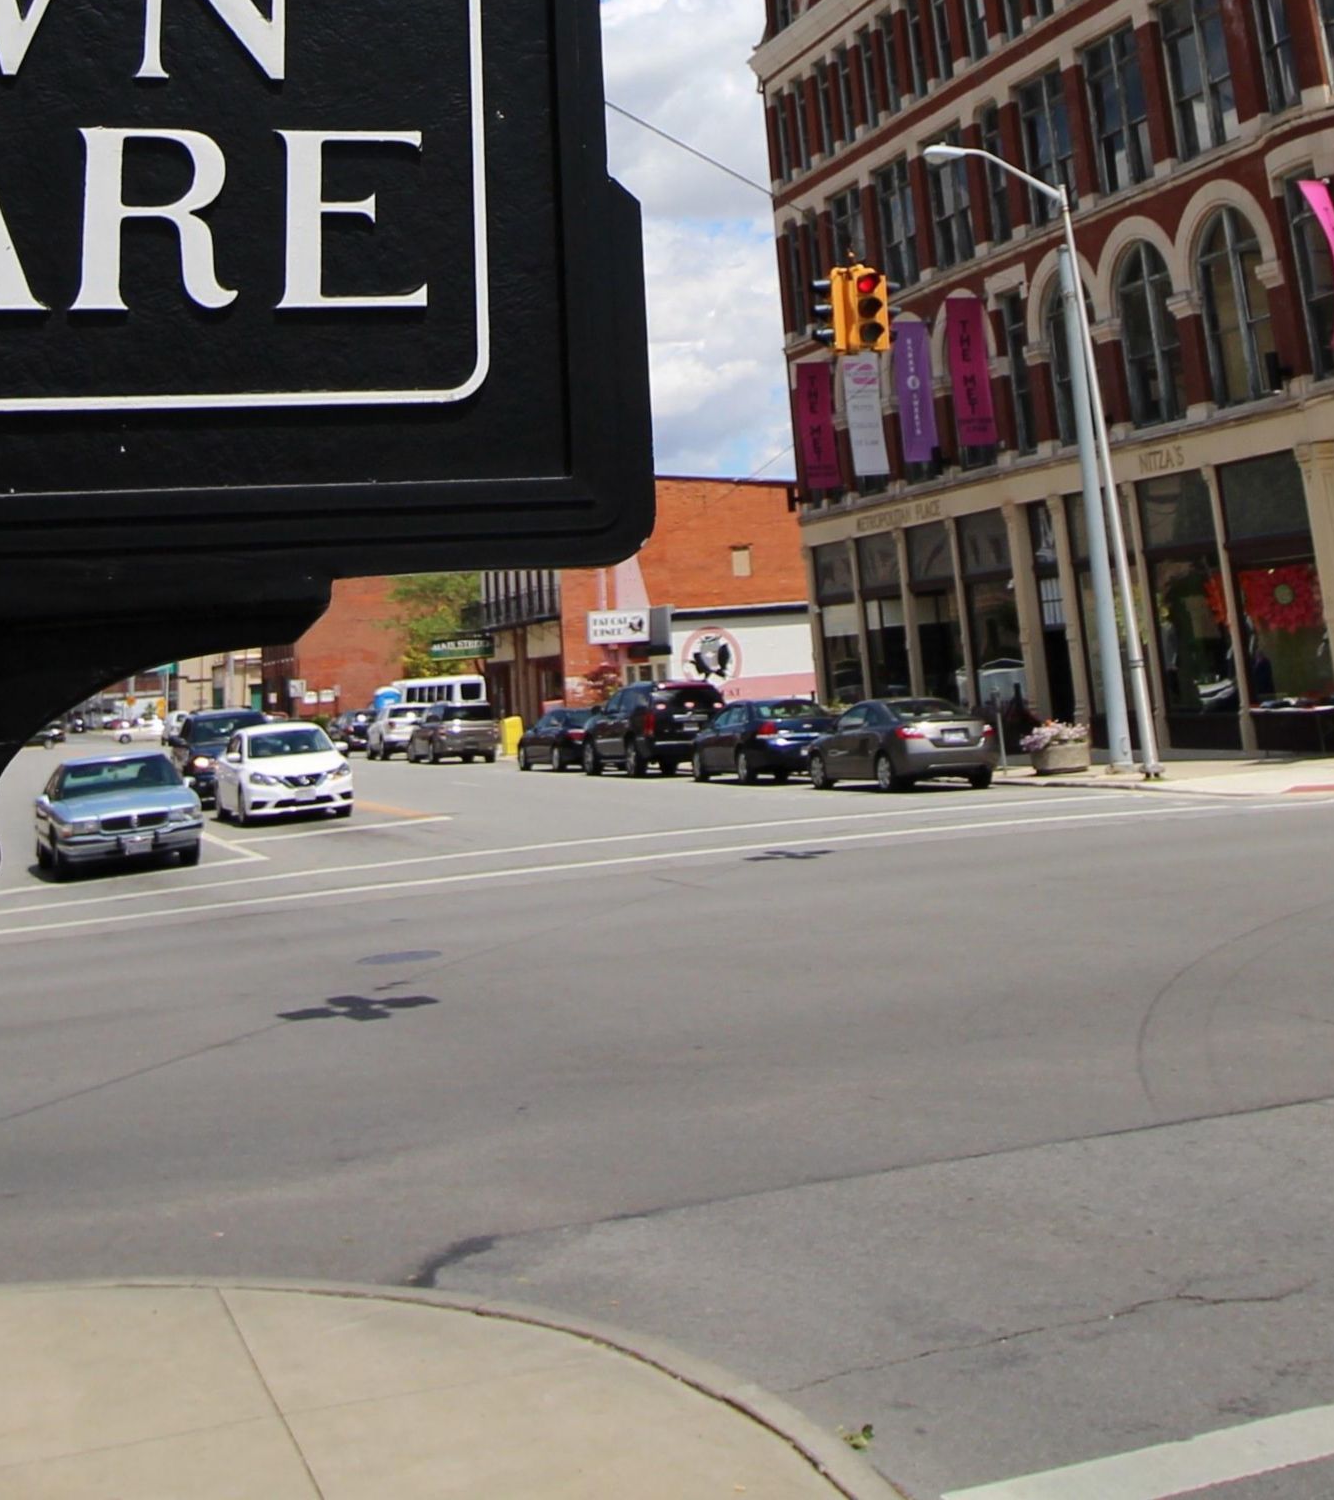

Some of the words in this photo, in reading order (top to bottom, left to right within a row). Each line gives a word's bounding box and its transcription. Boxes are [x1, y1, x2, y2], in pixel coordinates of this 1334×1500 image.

[959, 319, 971, 363] THE
[962, 374, 978, 416] MET
[1139, 445, 1185, 474] NITZA'S
